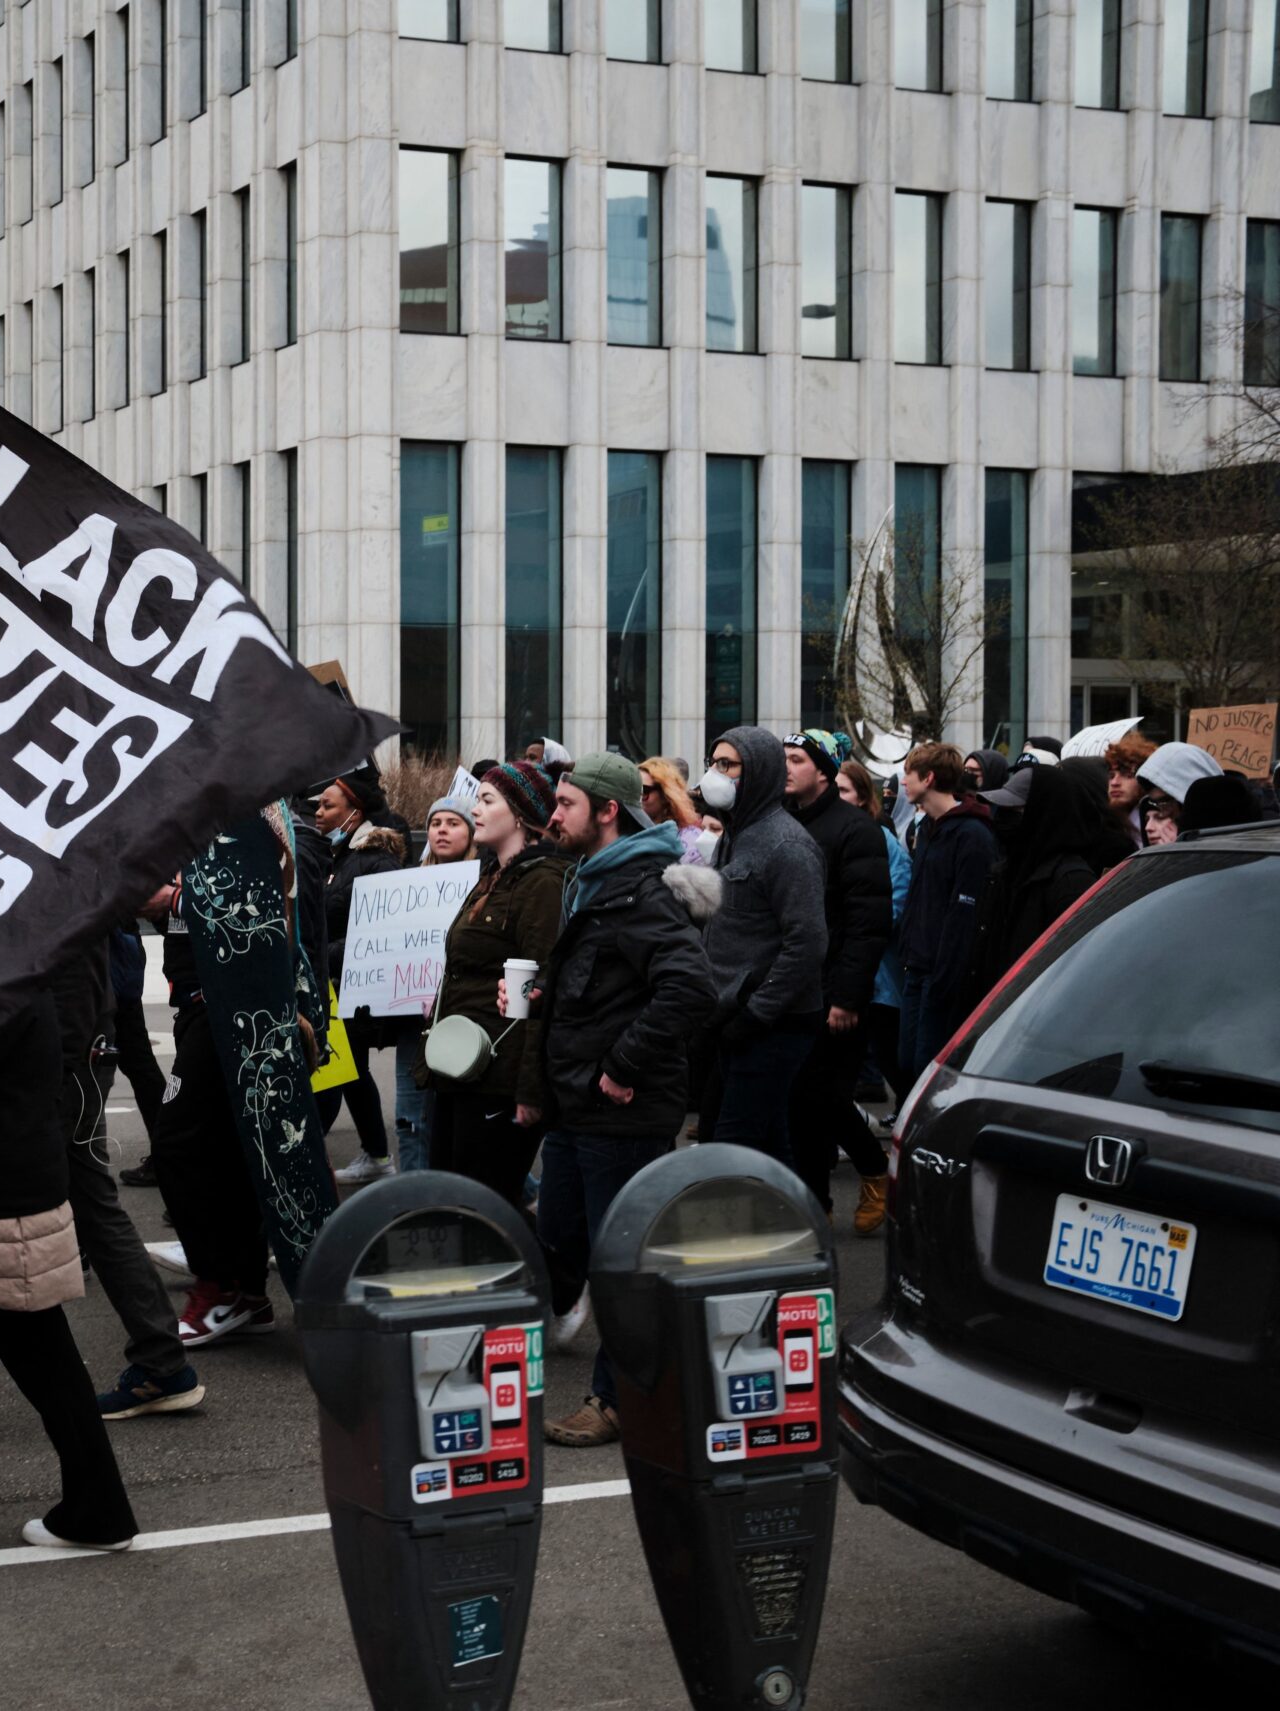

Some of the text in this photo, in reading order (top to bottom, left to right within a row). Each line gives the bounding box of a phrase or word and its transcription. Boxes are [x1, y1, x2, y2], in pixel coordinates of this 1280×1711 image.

[1195, 713, 1220, 734] NO
[354, 879, 469, 927] WHO DO YOU
[353, 937, 393, 961] CALL
[344, 967, 386, 990] POLICE
[1091, 1213, 1156, 1235] PURE MICHIGAN
[1055, 1222, 1178, 1296] EJS 7661
[777, 1309, 817, 1322] MOTU
[484, 1341, 525, 1356] MOTU
[744, 1506, 801, 1524] DUNCAN
[749, 1519, 797, 1536] METER
